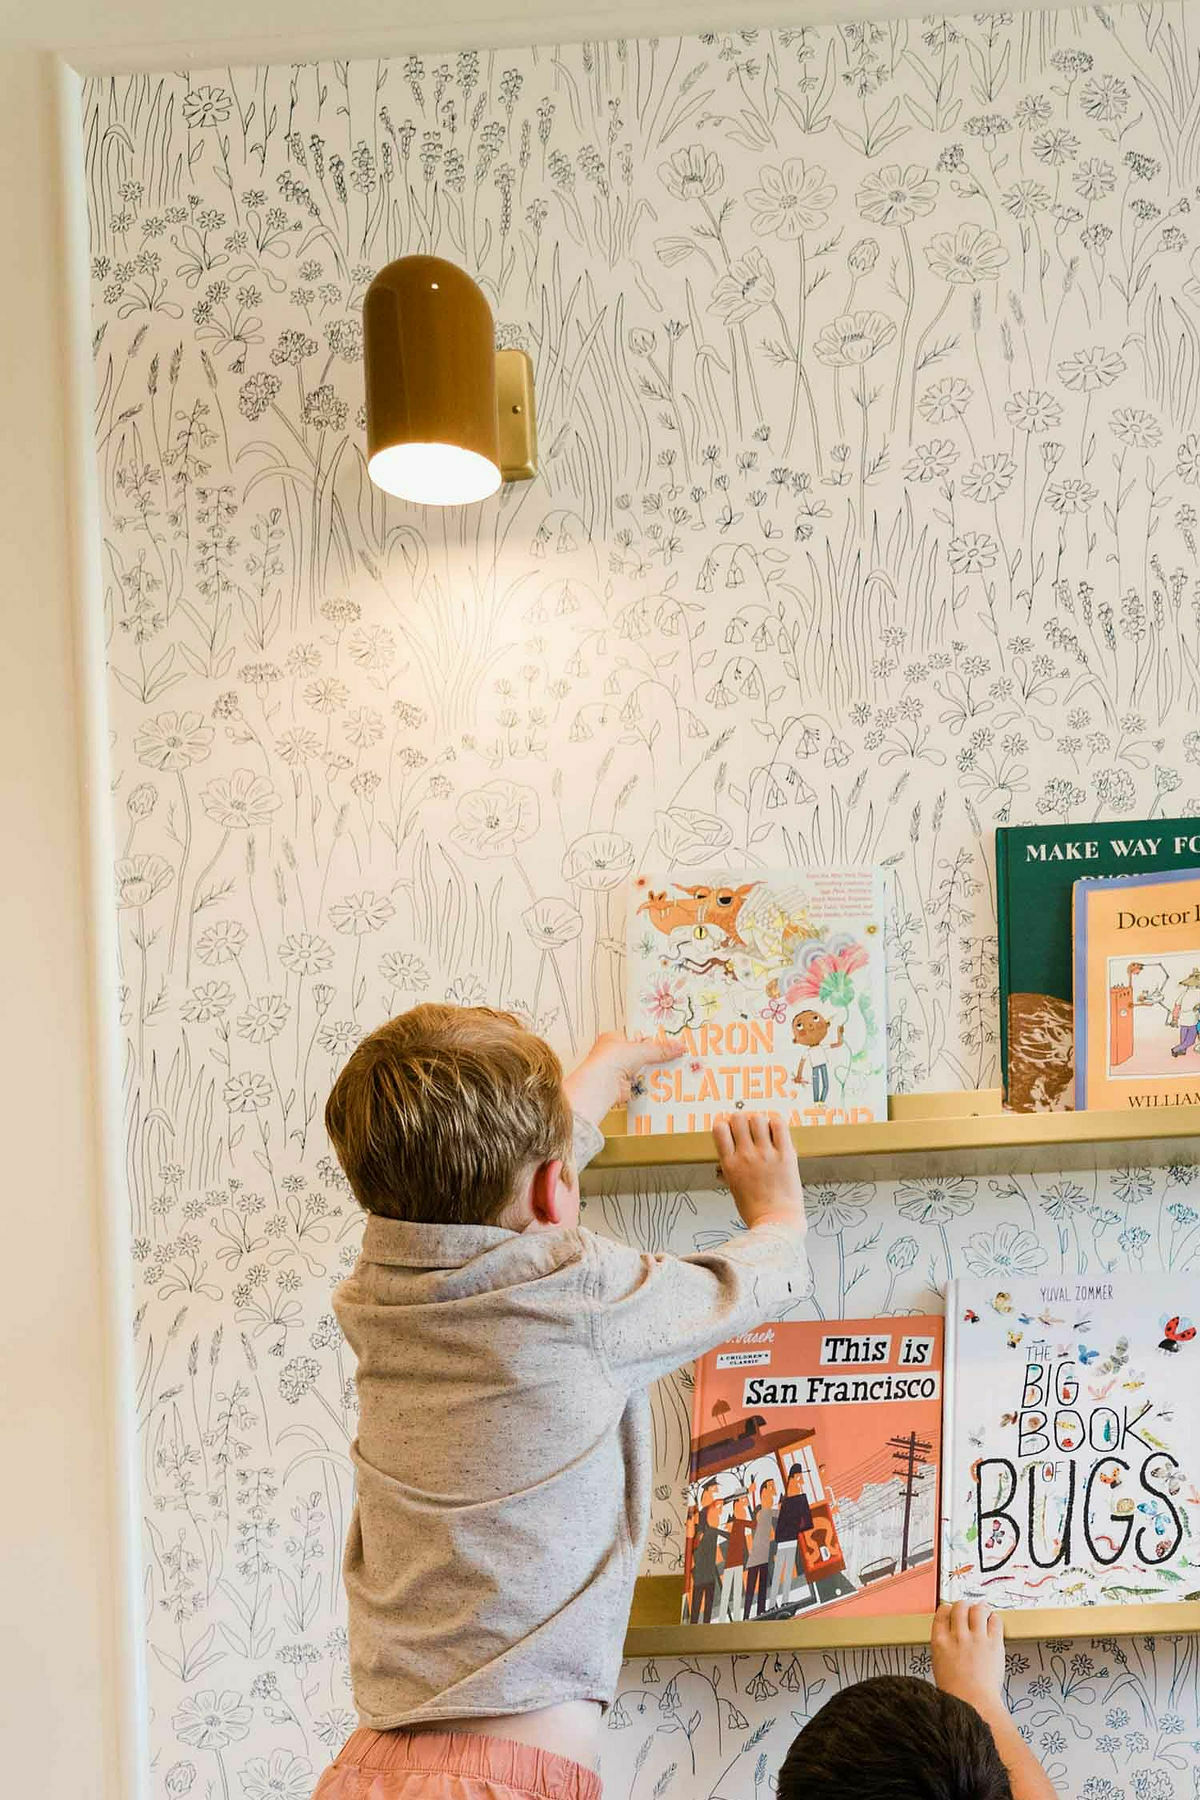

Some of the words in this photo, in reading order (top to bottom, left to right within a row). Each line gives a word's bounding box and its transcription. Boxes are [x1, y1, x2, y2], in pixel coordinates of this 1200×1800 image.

[1025, 842, 1099, 862] MAKE
[1110, 837, 1162, 857] WAY
[1116, 909, 1191, 931] Doctor
[1040, 1286, 1072, 1301] YUVAL
[1075, 1284, 1114, 1300] ZOMMER
[825, 1337, 888, 1363] This
[902, 1339, 929, 1363] is
[1025, 1346, 1050, 1362] THE
[746, 1379, 798, 1405] San
[806, 1376, 935, 1402] Francisco
[1021, 1361, 1079, 1408] BIG
[1018, 1405, 1153, 1457] BOOK
[1042, 1461, 1064, 1483] OF
[976, 1452, 1183, 1572] BUGS
